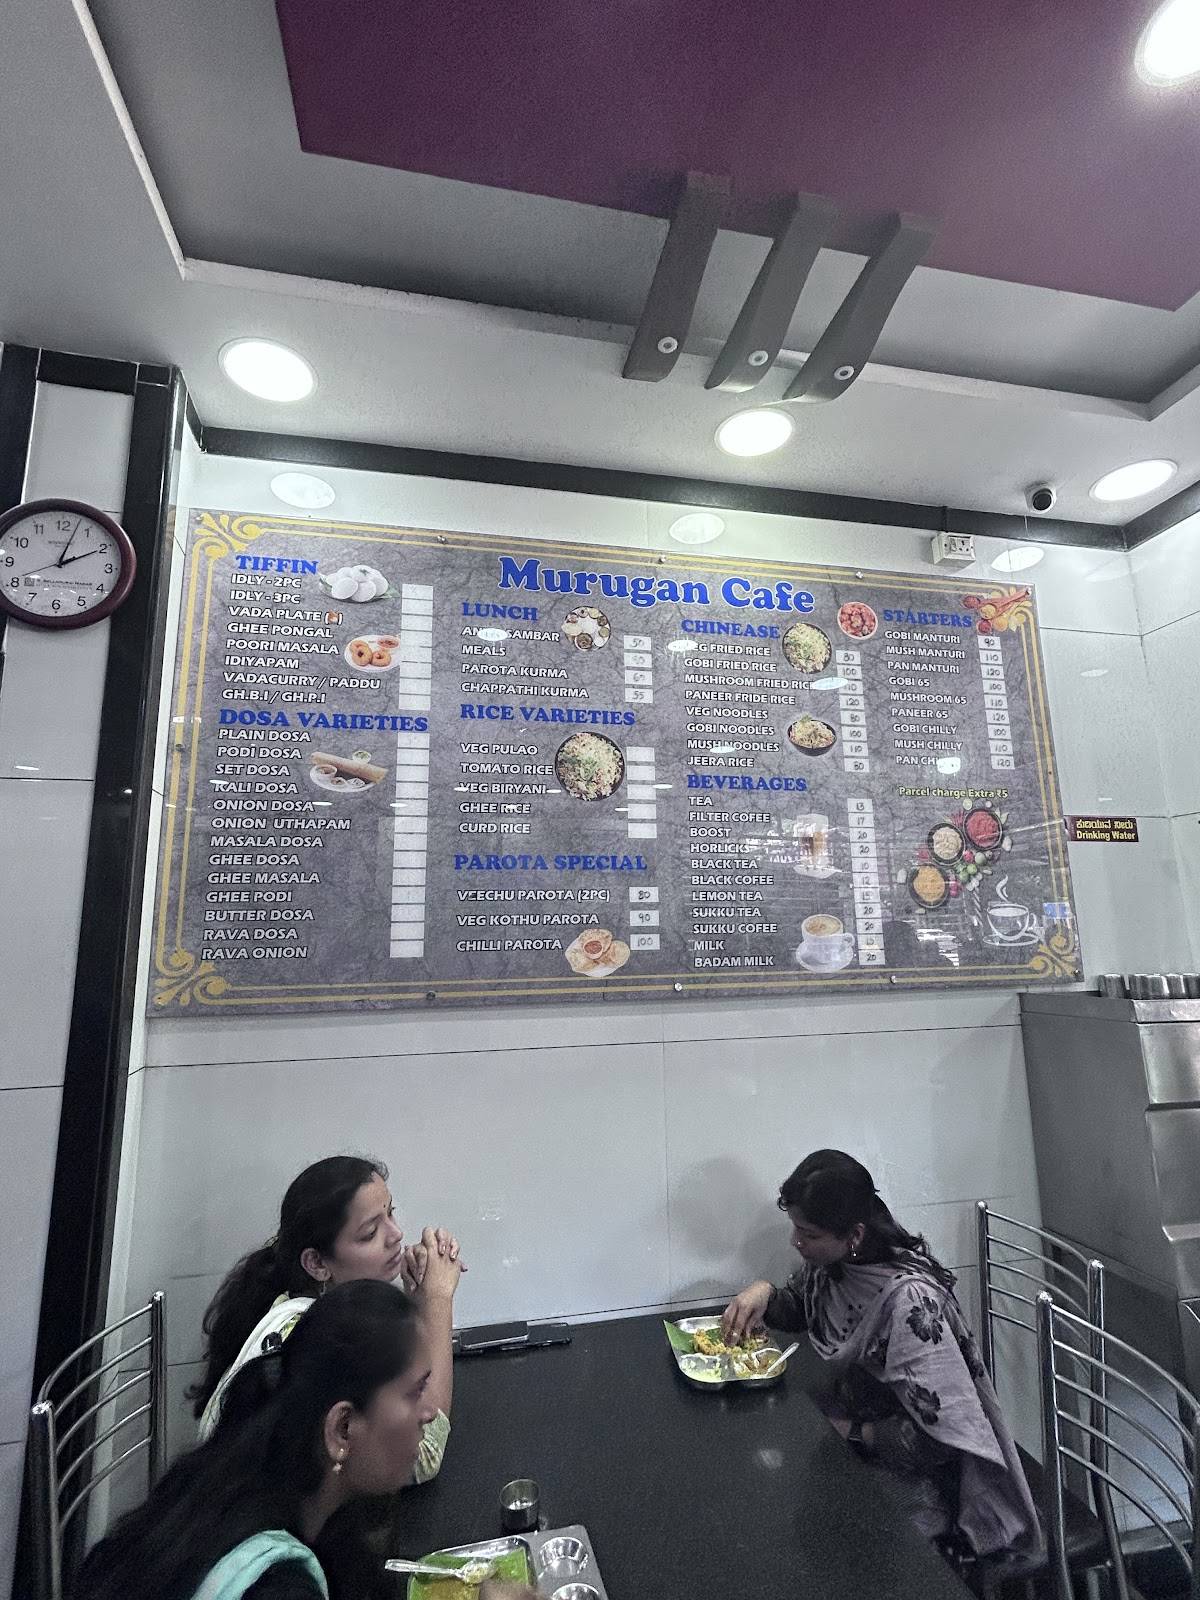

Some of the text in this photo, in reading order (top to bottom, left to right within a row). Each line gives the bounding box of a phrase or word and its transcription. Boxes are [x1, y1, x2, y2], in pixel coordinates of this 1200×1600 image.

[34, 524, 44, 534] 11
[57, 521, 70, 531] 12
[85, 528, 89, 537] 1
[15, 538, 28, 548] 10
[99, 544, 107, 553] 2
[5, 556, 14, 567] 9
[236, 555, 319, 574] TIFFIN
[104, 564, 112, 574] 3
[11, 577, 19, 587] 8
[231, 574, 301, 588] IDLY 2PC
[498, 556, 815, 614] Murugan Cafe
[96, 584, 103, 592] 4
[28, 593, 37, 601] 7
[77, 596, 86, 606] 5
[230, 590, 300, 603] IDLY 3PC
[52, 600, 60, 610] 6
[228, 606, 321, 620] VADA PLATE
[462, 602, 538, 621] LUNCH
[883, 609, 972, 627] STARTERS
[227, 623, 333, 638] GHEE PONGAL
[681, 619, 780, 639] CHINEASE
[885, 631, 960, 643] GOBI MANTURI
[226, 639, 339, 654] POORI MASALA
[462, 645, 506, 656] MEALS
[711, 645, 743, 654] FRIED
[746, 647, 770, 656] RICE
[887, 646, 965, 658] MUSH MANTURI
[225, 656, 299, 668] IDIYAPAM
[685, 659, 777, 672] GOBI FRIED RICE
[888, 662, 959, 673] PAN MANTURI
[462, 664, 568, 679] PAROTA KURMA
[224, 672, 380, 689] VADACURRY PADDU
[685, 674, 789, 688] MUSHROOM FRIED
[889, 677, 930, 687] GOBI 65
[461, 683, 589, 698] CHAPPATHI KURMA
[222, 690, 326, 703] GH.B.I GH.P.I
[685, 691, 795, 704] PANEER FRIDE RICE
[890, 693, 967, 704] MUSHROOM 65
[460, 704, 635, 725] RICE VARIETIES
[686, 707, 768, 719] VEG NOODLES
[892, 708, 948, 718] PANEER 65
[219, 709, 428, 731] DOSA VARIETIES
[687, 723, 774, 735] GOBI NOODLES
[893, 724, 957, 734] GOBI CHILLY
[218, 730, 311, 742] PLAIN DOSA
[461, 744, 538, 755] VEG PULAO
[894, 740, 962, 750] MUSH CHILLY
[259, 748, 302, 759] DOSA
[688, 756, 754, 767] JEERA RICE
[896, 756, 918, 764] PAN
[216, 764, 290, 776] SET DOSA
[461, 763, 553, 774] TOMATO RICE
[254, 783, 298, 793] DOSA
[687, 775, 807, 791] BEVERAGES
[491, 784, 546, 794] BIRYANI
[899, 787, 929, 796] Parcel
[933, 787, 965, 798] charge
[968, 789, 995, 798] Extra
[213, 800, 314, 811] ONION DOSA
[689, 797, 712, 806] TEA
[460, 803, 497, 813] GHEE
[689, 812, 770, 823] FILTER COFEE
[212, 818, 350, 830] ONION UTHAPAM
[460, 823, 530, 833] CURD RICE
[690, 828, 731, 837] BOOST
[1077, 831, 1135, 841] Drinking Water
[210, 836, 323, 847] MASALA DOSA
[690, 844, 749, 853] HORLICKS
[209, 855, 300, 865] GHEE DOSA
[454, 854, 647, 871] PAROTA SPECIAL
[691, 860, 758, 869] BLACK TEA
[207, 873, 320, 883] GHEE MASALA
[691, 875, 774, 885] BLACK COFEE
[206, 892, 292, 902] GHEE PODI
[457, 890, 609, 902] VEECHU PAROTA (2PC)
[692, 892, 763, 901] LEMON TEA
[205, 910, 314, 921] BUTTER DOSA
[639, 913, 650, 922] 90
[692, 907, 761, 917] SUKKU TEA
[457, 914, 598, 926] VEG KOTHU PAROTA
[203, 929, 298, 940] RAVA DOSA
[693, 924, 777, 934] SUKKU COFEE
[457, 940, 562, 951] CHILLI PAROTA
[637, 938, 653, 946] 100
[694, 940, 724, 950] MILK
[201, 947, 308, 960] RAVA ONION
[694, 956, 774, 967] BADAM MILK
